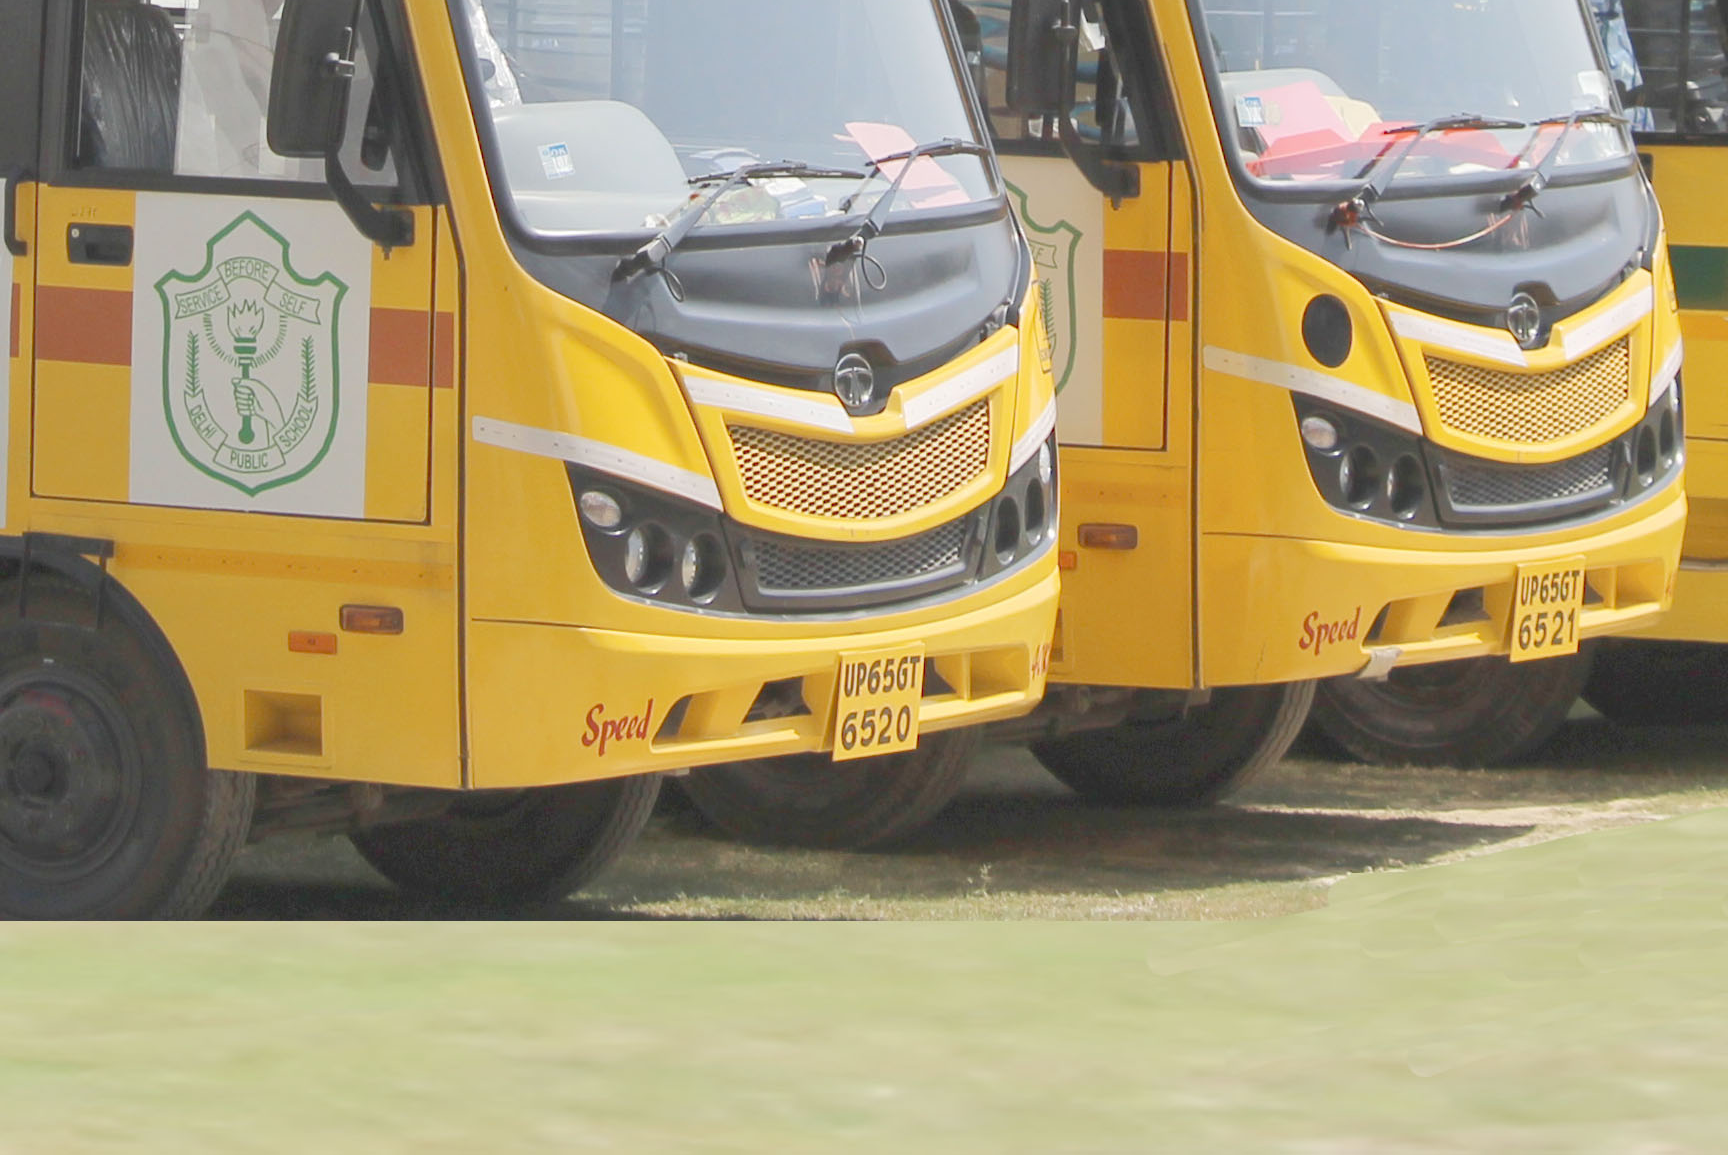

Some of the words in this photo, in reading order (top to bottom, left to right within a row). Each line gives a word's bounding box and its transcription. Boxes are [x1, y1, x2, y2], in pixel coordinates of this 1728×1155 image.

[180, 284, 223, 315] SERVICE
[224, 259, 270, 281] BEFORE
[278, 292, 307, 316] SELF
[188, 403, 218, 439] DELHI
[230, 450, 270, 470] PUBLIC
[278, 402, 314, 447] SCHOOL
[1520, 569, 1581, 605] UP65GT
[1298, 605, 1362, 656] Speed
[1518, 607, 1576, 652] 6521
[842, 654, 922, 699] UP65GT
[580, 698, 654, 758] Speed
[840, 704, 912, 751] 6520
